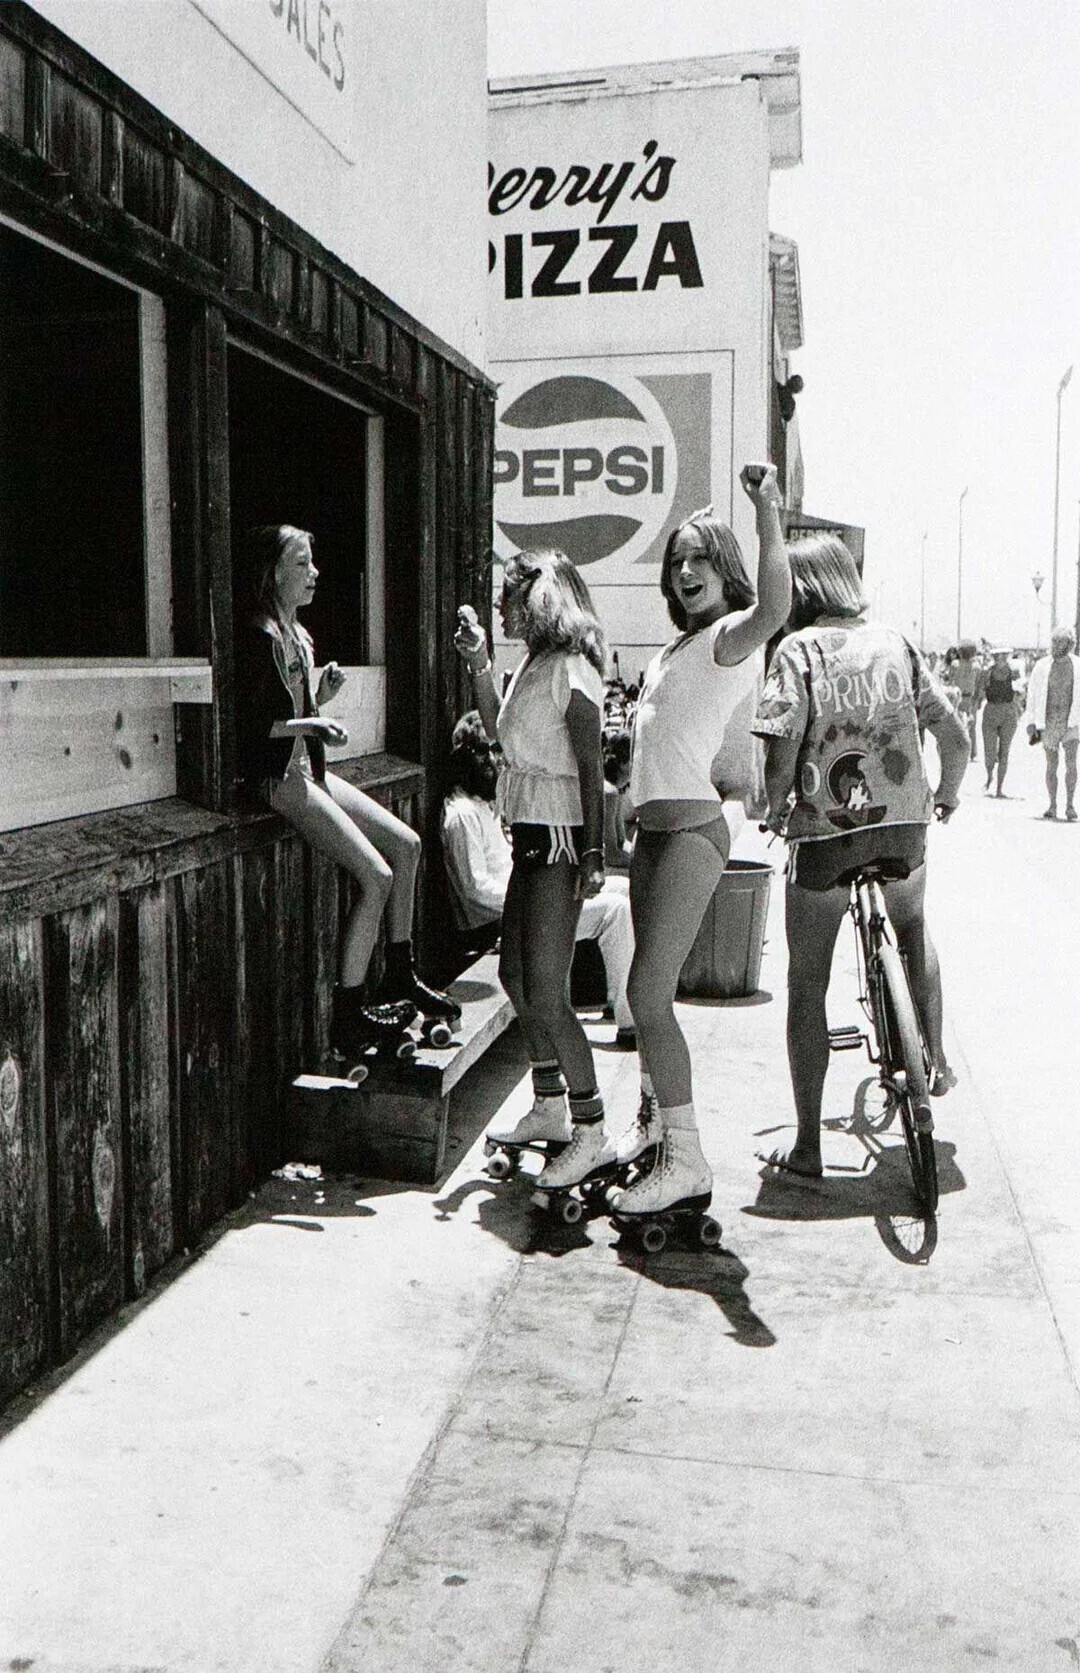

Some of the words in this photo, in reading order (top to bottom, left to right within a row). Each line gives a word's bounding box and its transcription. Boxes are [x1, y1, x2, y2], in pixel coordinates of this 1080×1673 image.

[269, 0, 345, 92] ALES
[488, 139, 677, 224] erry's
[488, 220, 705, 300] IZZA
